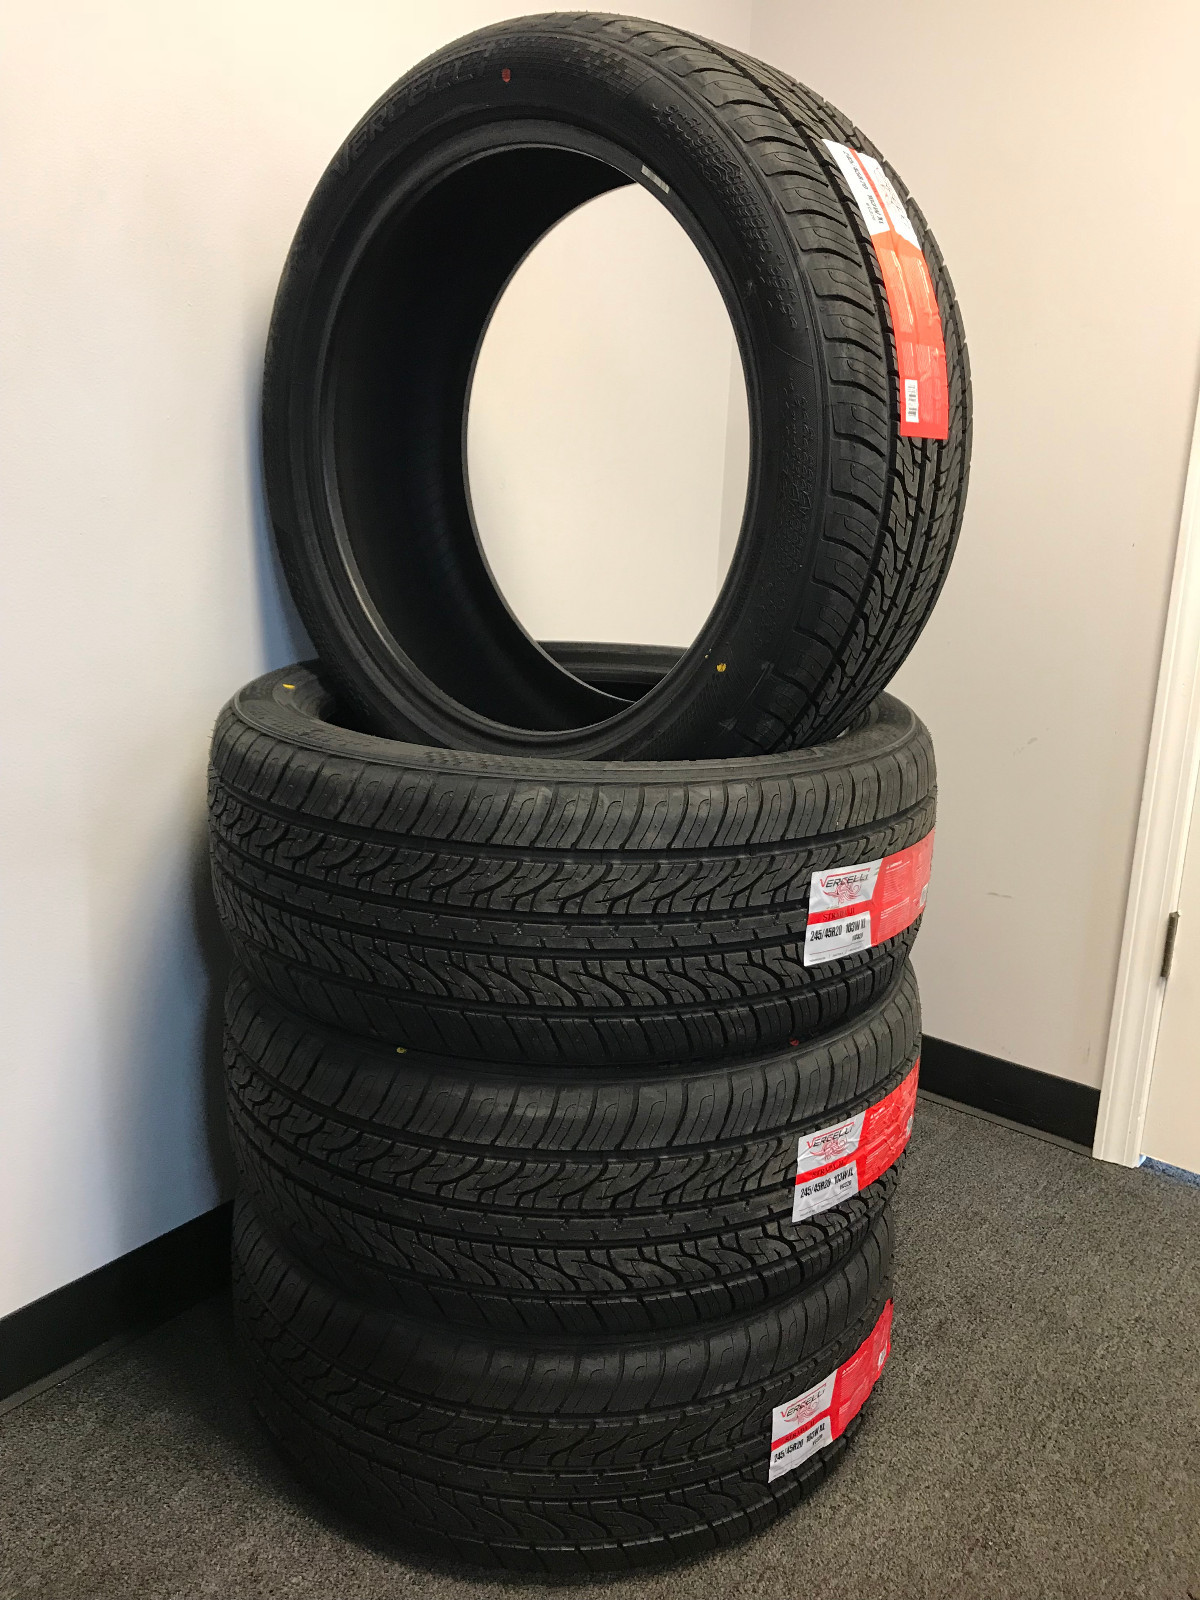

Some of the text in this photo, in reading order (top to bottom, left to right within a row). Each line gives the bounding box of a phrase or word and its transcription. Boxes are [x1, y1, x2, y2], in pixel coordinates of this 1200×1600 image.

[819, 868, 871, 888] VERCELLI
[809, 925, 843, 942] 245/45R20
[806, 1121, 855, 1149] VERCELLI
[800, 1178, 832, 1199] 245/45R20
[773, 1439, 804, 1463] 245/45R20
